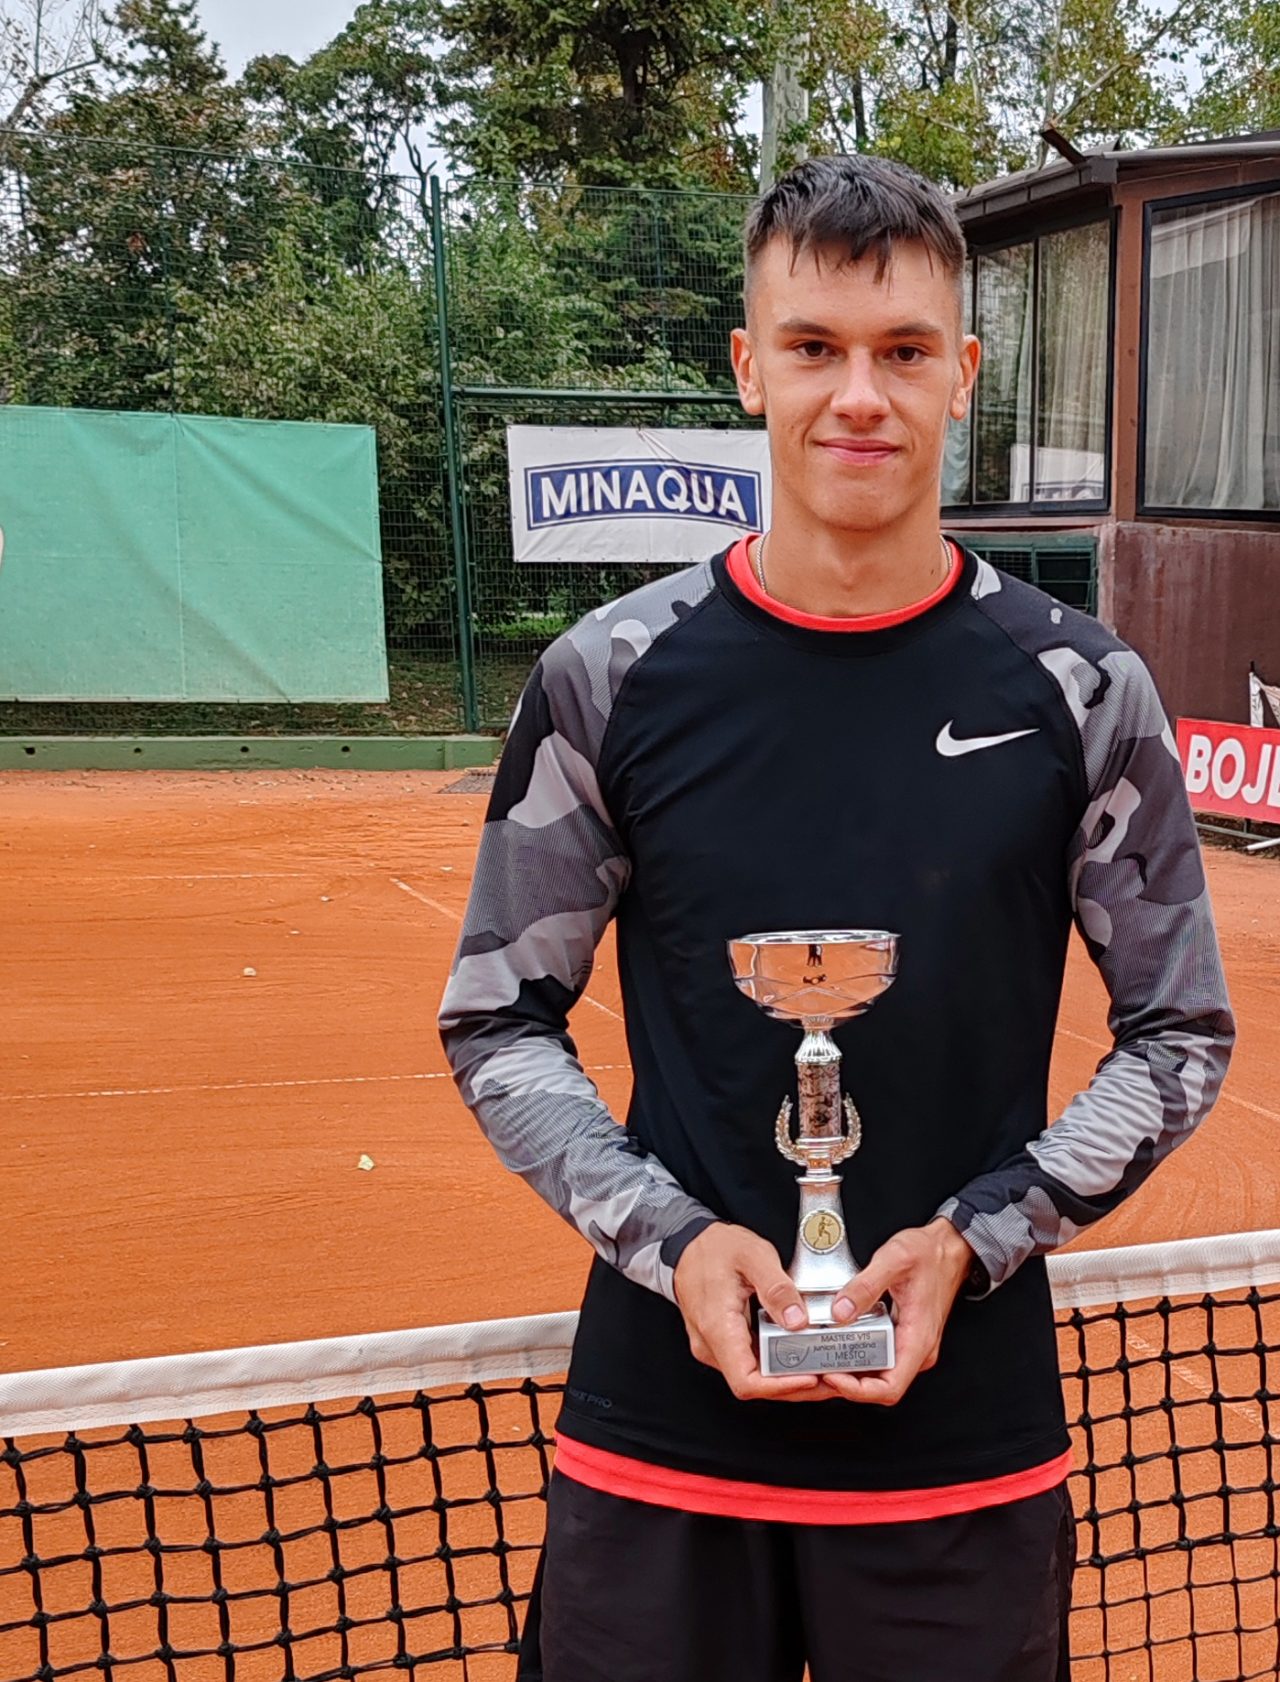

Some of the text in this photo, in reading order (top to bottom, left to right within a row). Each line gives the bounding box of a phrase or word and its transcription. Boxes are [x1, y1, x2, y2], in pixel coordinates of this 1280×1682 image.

[540, 469, 748, 522] MINAQUA
[821, 1333, 871, 1342] MASTERS VTS
[835, 1350, 866, 1361] MESTO
[587, 1393, 613, 1409] PRO
